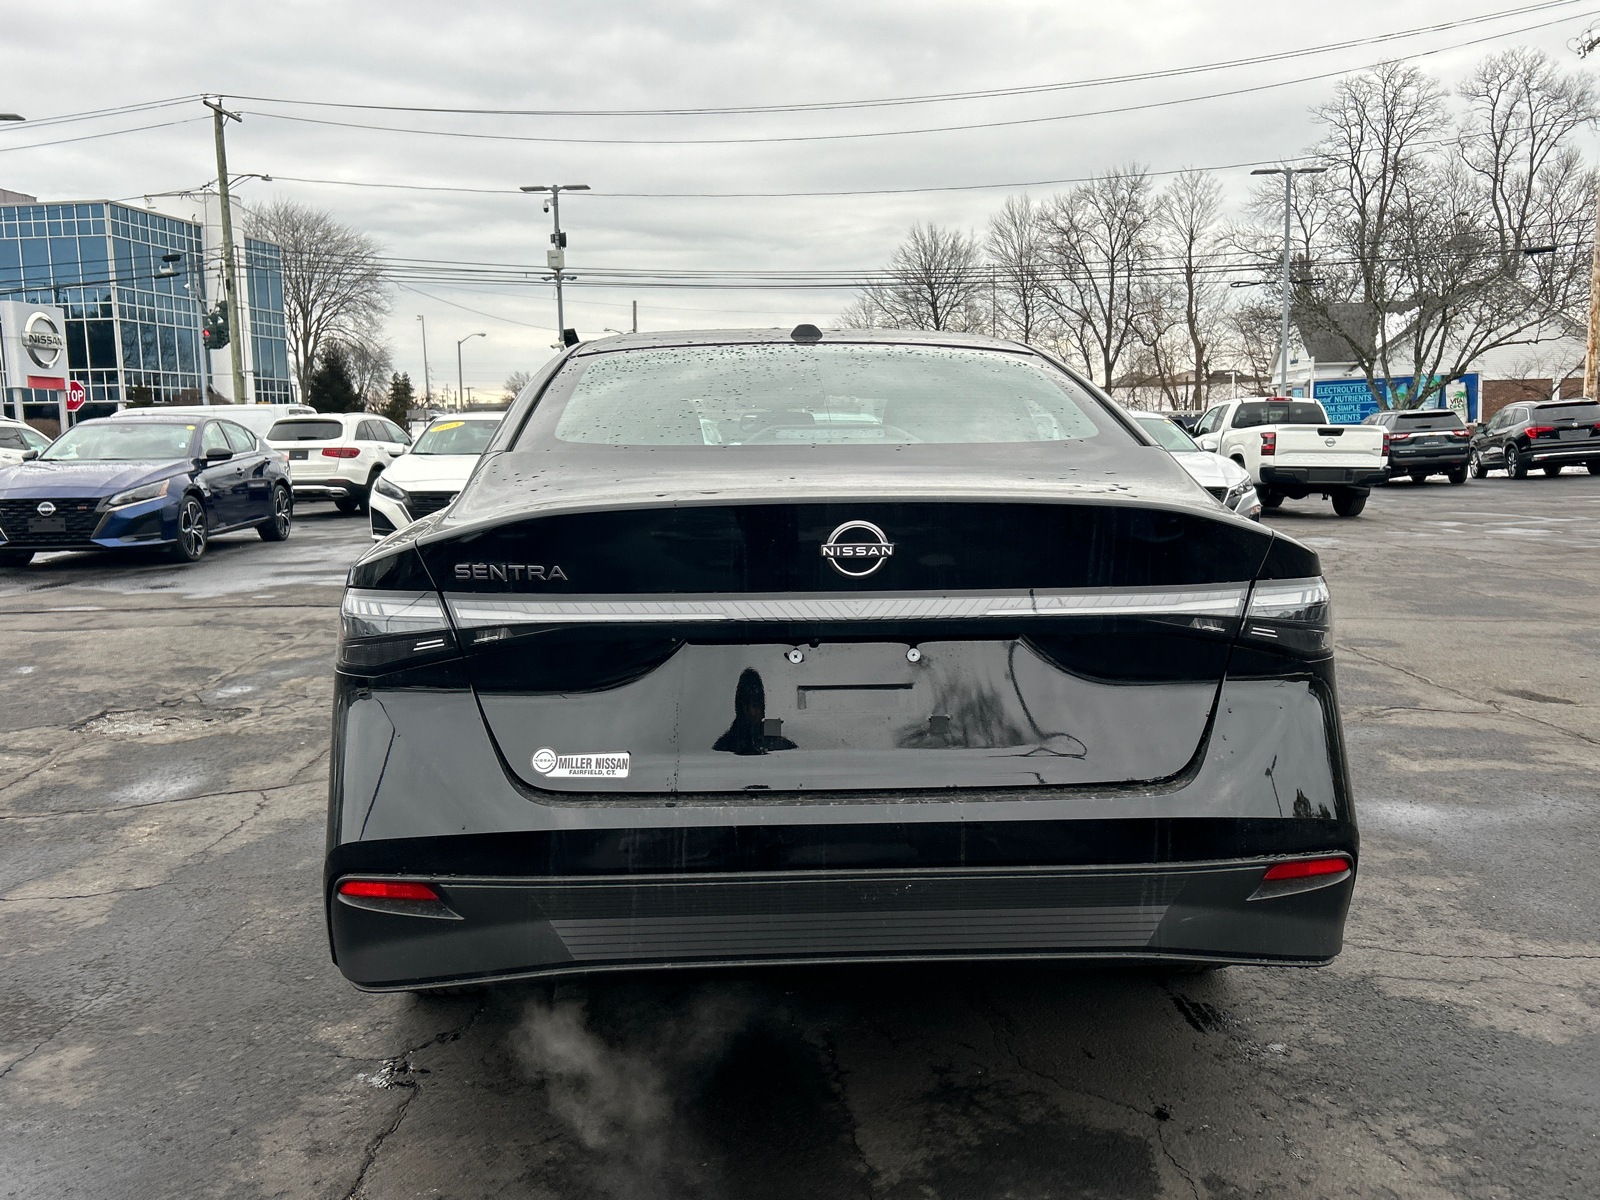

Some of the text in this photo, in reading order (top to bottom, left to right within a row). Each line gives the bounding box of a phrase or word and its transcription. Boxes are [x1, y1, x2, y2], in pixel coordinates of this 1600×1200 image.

[28, 334, 63, 345] NISSAN
[1316, 385, 1367, 395] ELECTROLYTES
[66, 391, 84, 401] TOP
[1334, 394, 1372, 403] NUTRIENTS
[1450, 397, 1463, 405] VITA
[1324, 405, 1335, 413] OM
[1336, 404, 1361, 413] SIMPLE
[1328, 413, 1361, 421] REDIENTS
[822, 546, 893, 556] NISSAN
[454, 564, 569, 581] SENTRA
[558, 757, 628, 769] MILLER NISSAN
